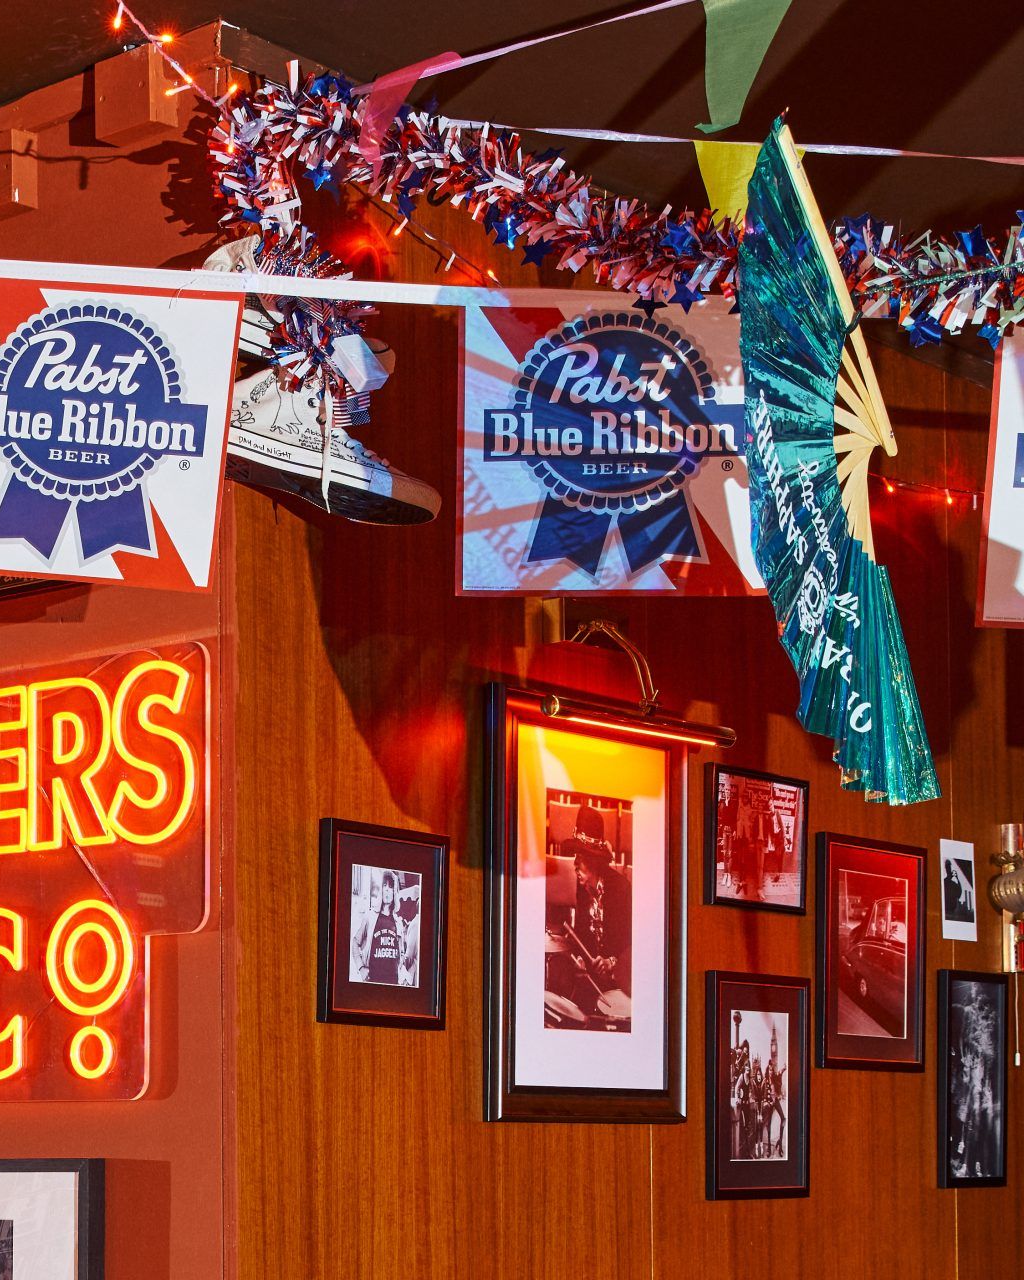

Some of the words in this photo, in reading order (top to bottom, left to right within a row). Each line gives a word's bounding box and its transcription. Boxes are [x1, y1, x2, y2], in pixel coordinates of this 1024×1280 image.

[24, 331, 147, 393] Pabst
[549, 344, 675, 404] Pabst
[59, 402, 196, 452] Ribbon
[491, 413, 582, 458] Blue
[588, 410, 738, 455] Ribbon
[49, 448, 110, 465] BEER
[582, 461, 649, 475] BEER
[753, 389, 810, 566] SAPPHIRE
